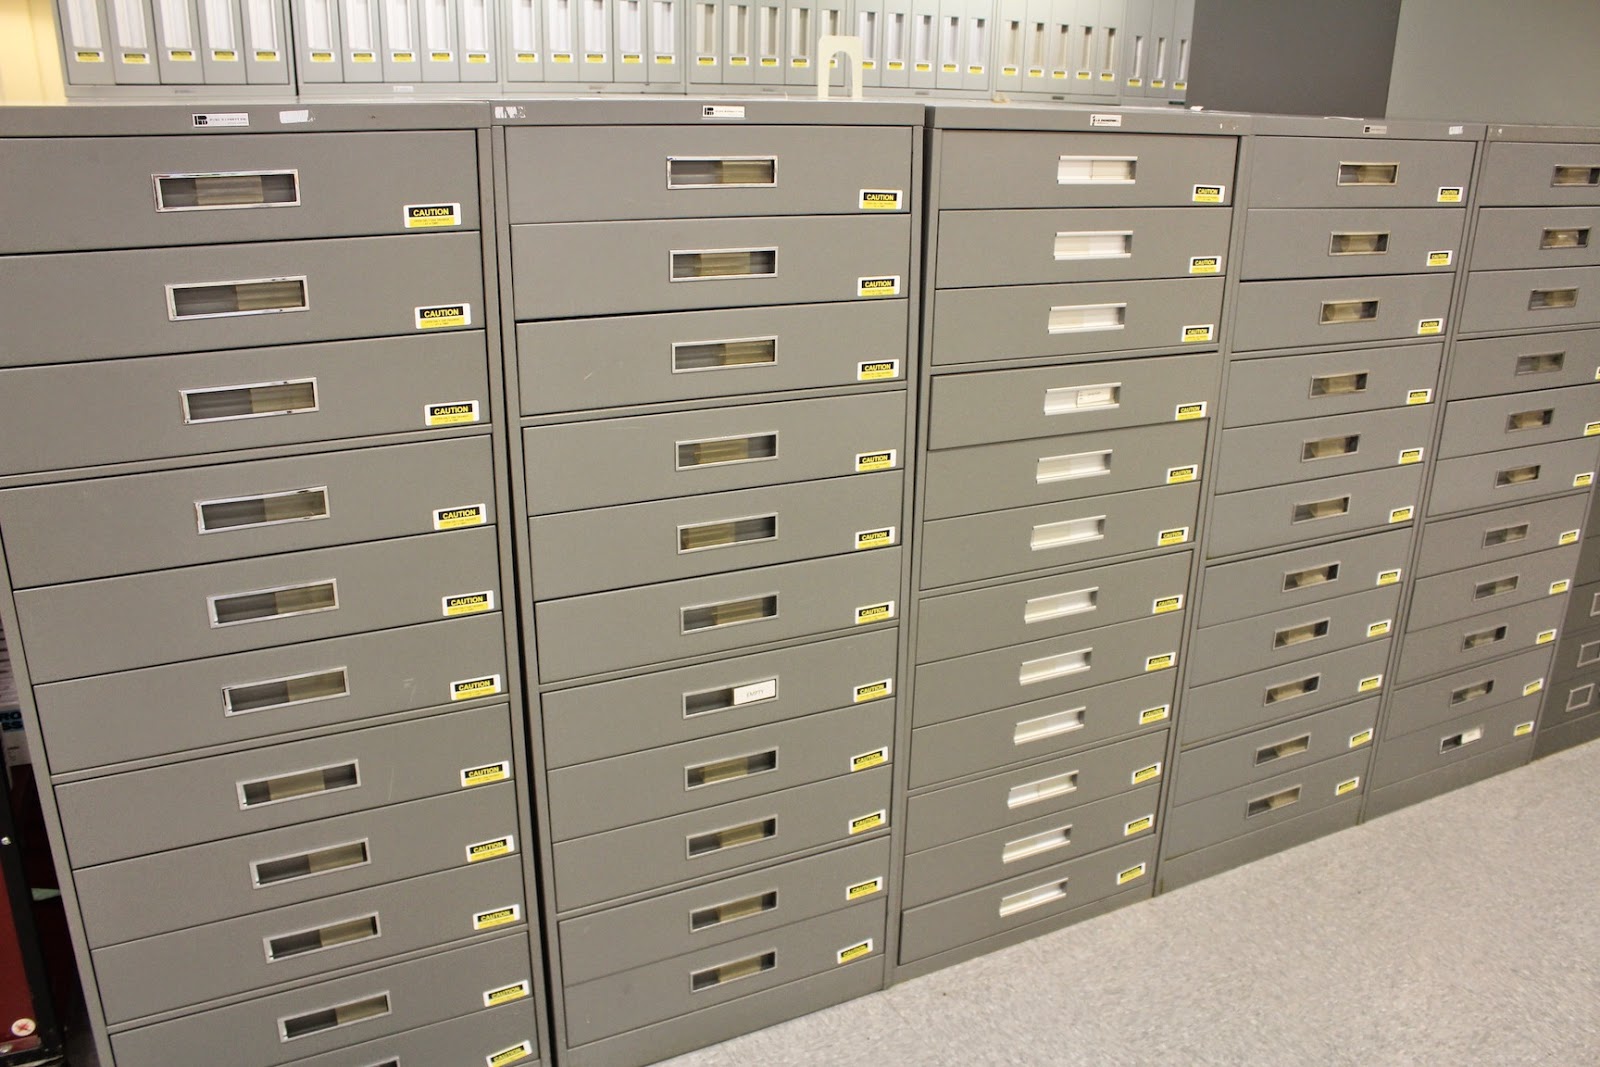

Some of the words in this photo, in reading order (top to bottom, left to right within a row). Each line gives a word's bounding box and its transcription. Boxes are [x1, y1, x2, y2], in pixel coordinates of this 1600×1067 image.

[413, 208, 449, 217] CAUTION
[864, 280, 892, 288] CAUTION
[424, 308, 459, 318] CAUTION
[864, 363, 891, 371] CAUTION
[434, 406, 469, 415] CAUTION
[862, 455, 888, 463] CAUTION
[1172, 469, 1192, 477] CAUTION
[442, 509, 476, 520] CAUTION
[861, 532, 887, 541] CAUTION
[1163, 531, 1183, 539] CAUTION
[450, 595, 483, 606] CAUTION
[861, 606, 887, 616] CAUTION
[458, 680, 491, 691] CAUTION
[860, 683, 885, 694] CAUTION
[856, 752, 881, 764] CAUTION
[468, 766, 499, 777] CAUTION
[855, 815, 879, 827] CAUTION
[473, 841, 503, 853] CAUTION
[480, 910, 511, 922] CAUTION
[491, 986, 521, 999] CAUTION
